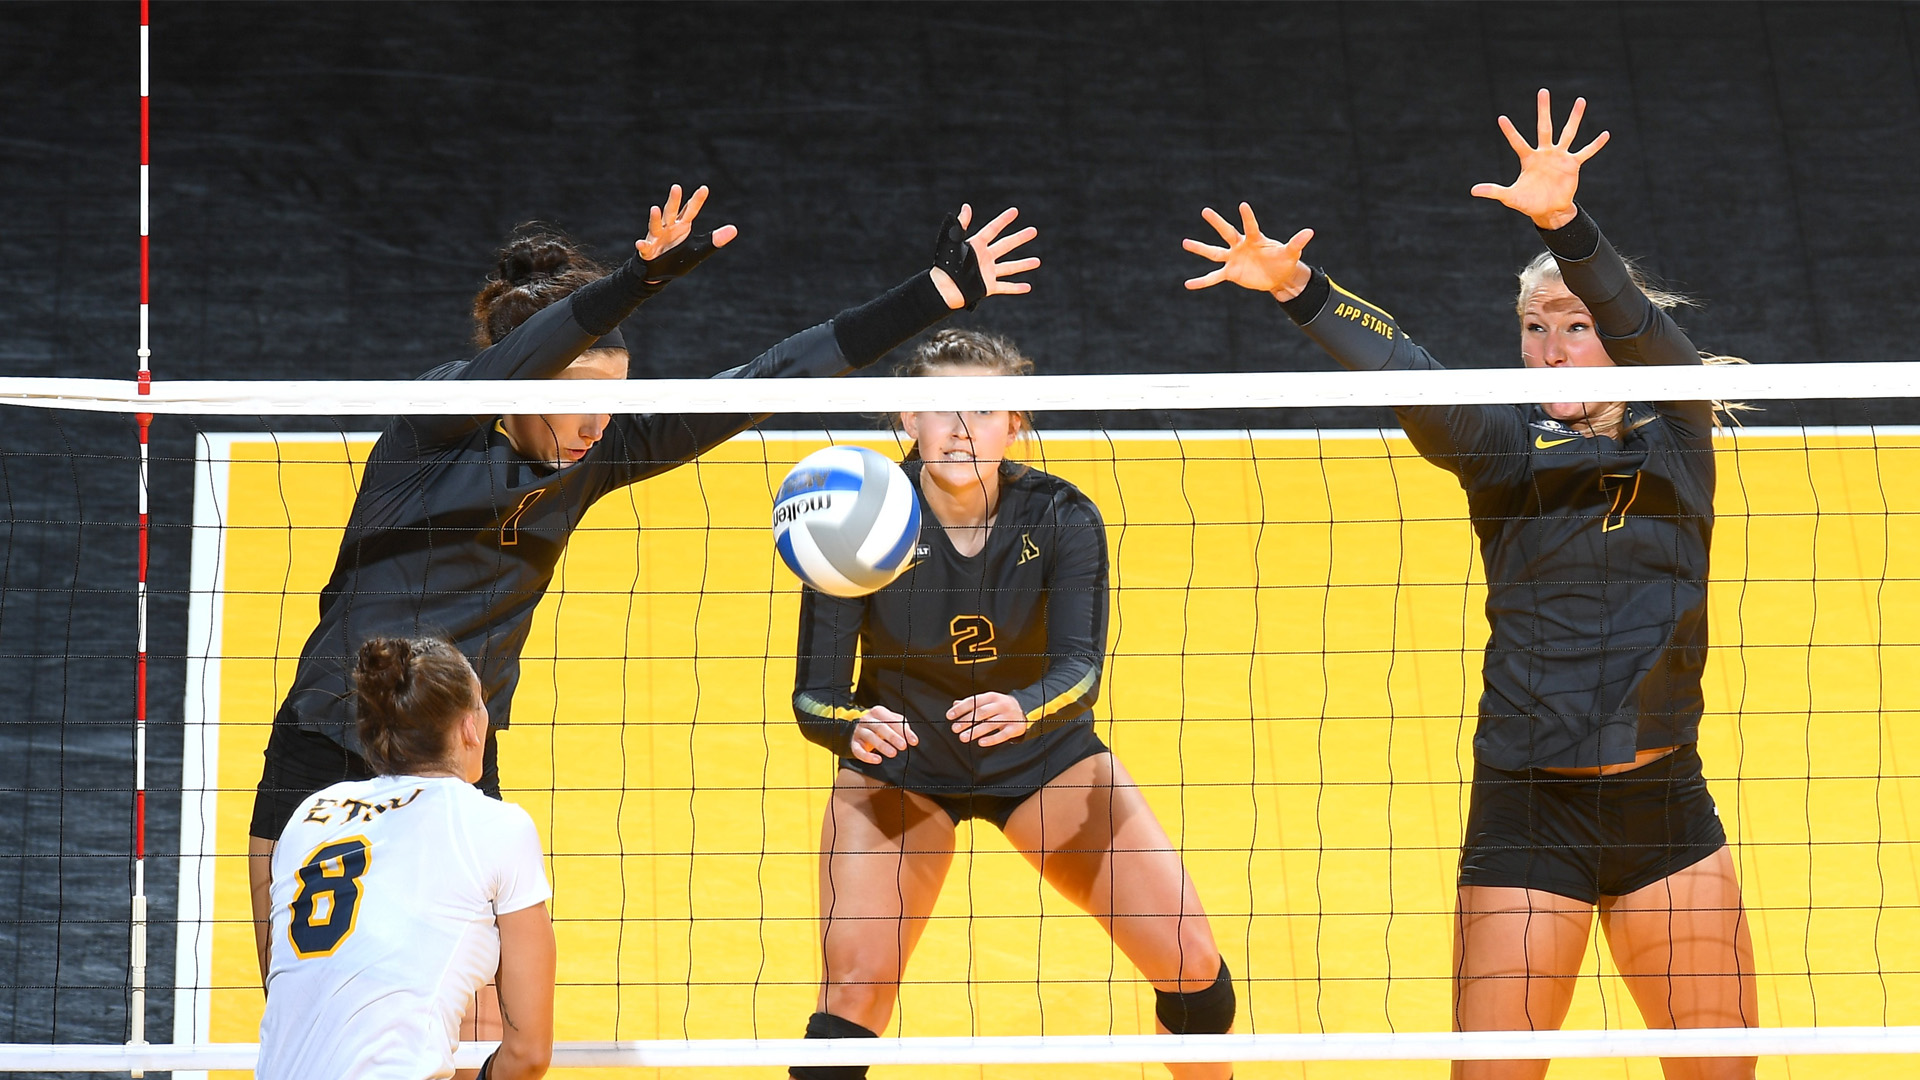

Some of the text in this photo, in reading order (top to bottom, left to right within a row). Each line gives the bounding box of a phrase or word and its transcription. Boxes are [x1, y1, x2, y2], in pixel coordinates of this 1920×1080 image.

[1334, 302, 1393, 340] APP STATE
[773, 494, 831, 527] molten
[1600, 469, 1641, 533] 7
[950, 615, 997, 664] 2
[288, 834, 372, 960] 8
